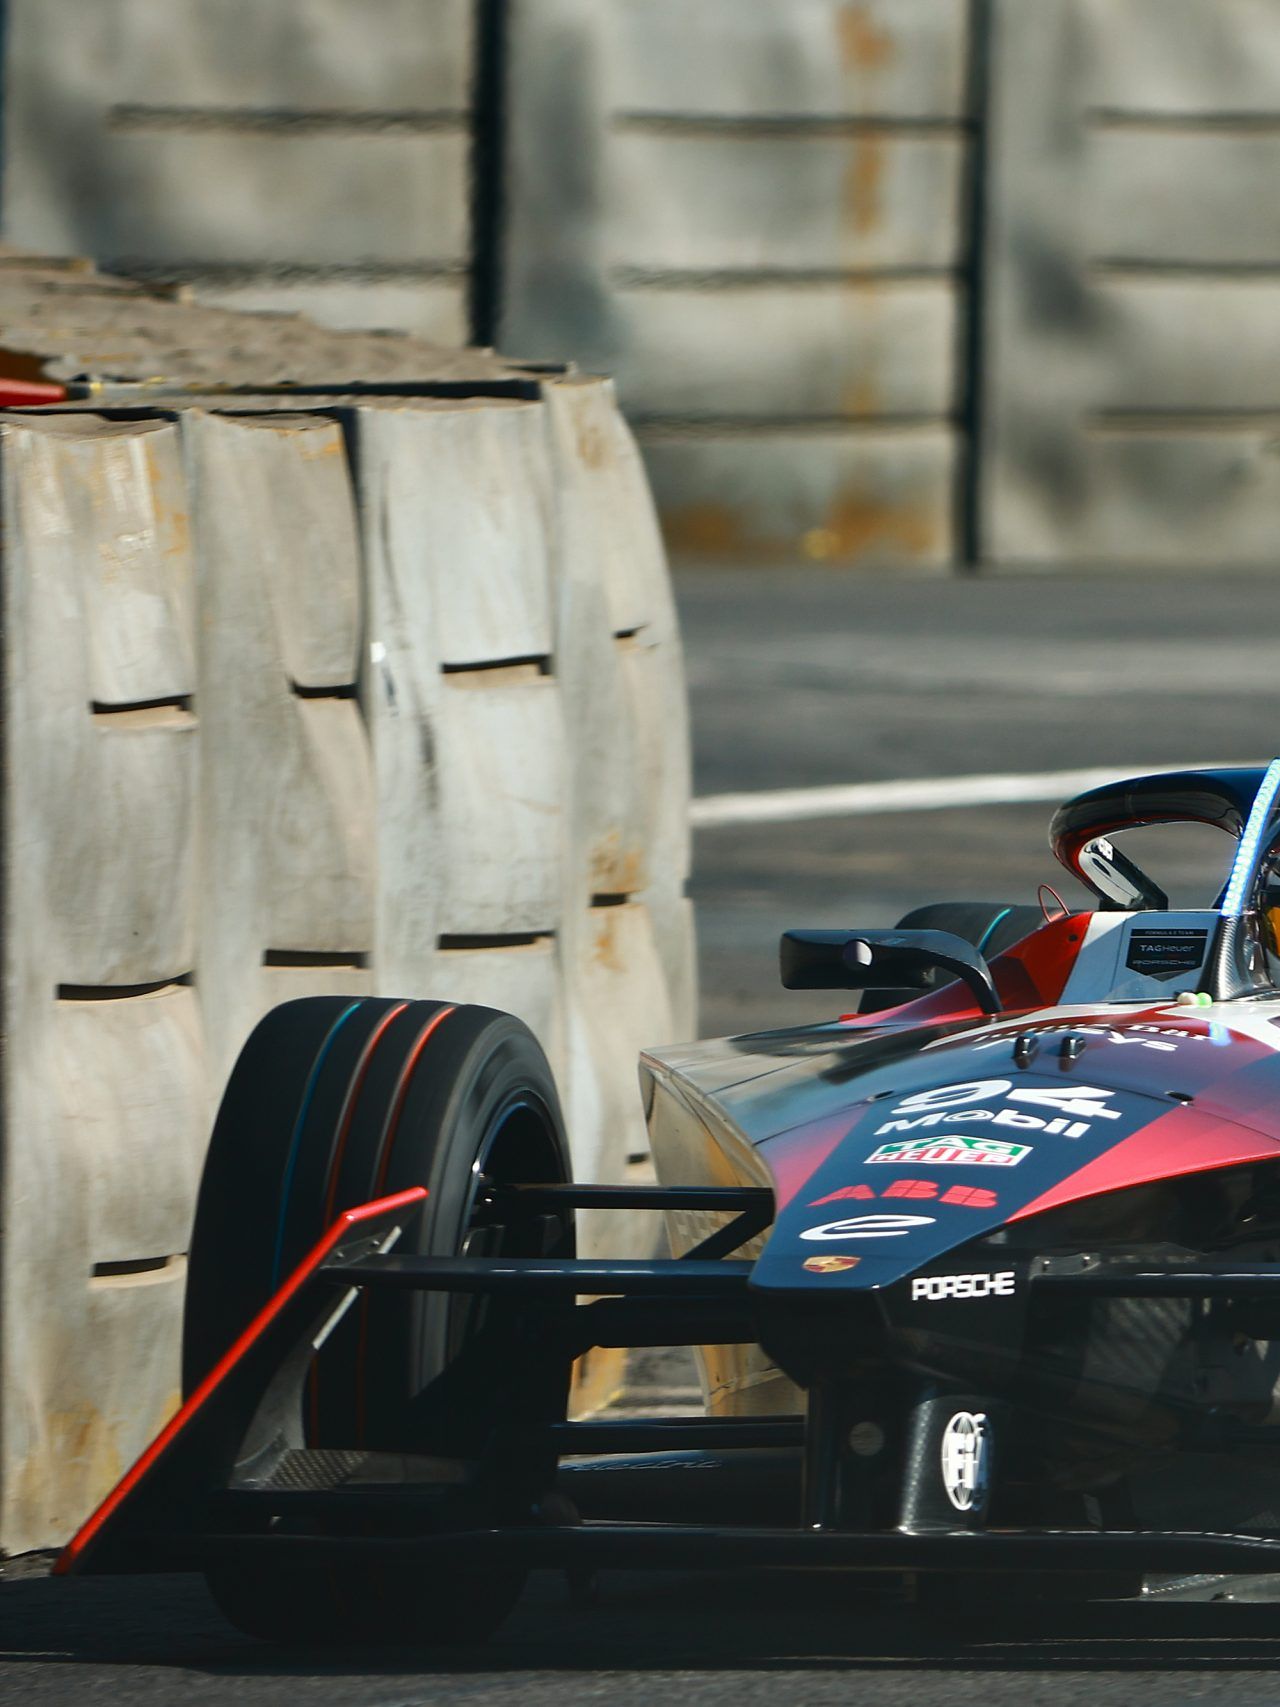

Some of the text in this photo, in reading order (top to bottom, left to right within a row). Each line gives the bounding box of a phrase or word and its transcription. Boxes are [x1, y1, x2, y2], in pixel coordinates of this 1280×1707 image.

[873, 1109, 1092, 1139] Mobil
[874, 1147, 1012, 1165] HEUER
[884, 1136, 1019, 1156] TAG
[805, 1179, 998, 1209] ABB
[911, 1271, 1016, 1301] PORSCHE
